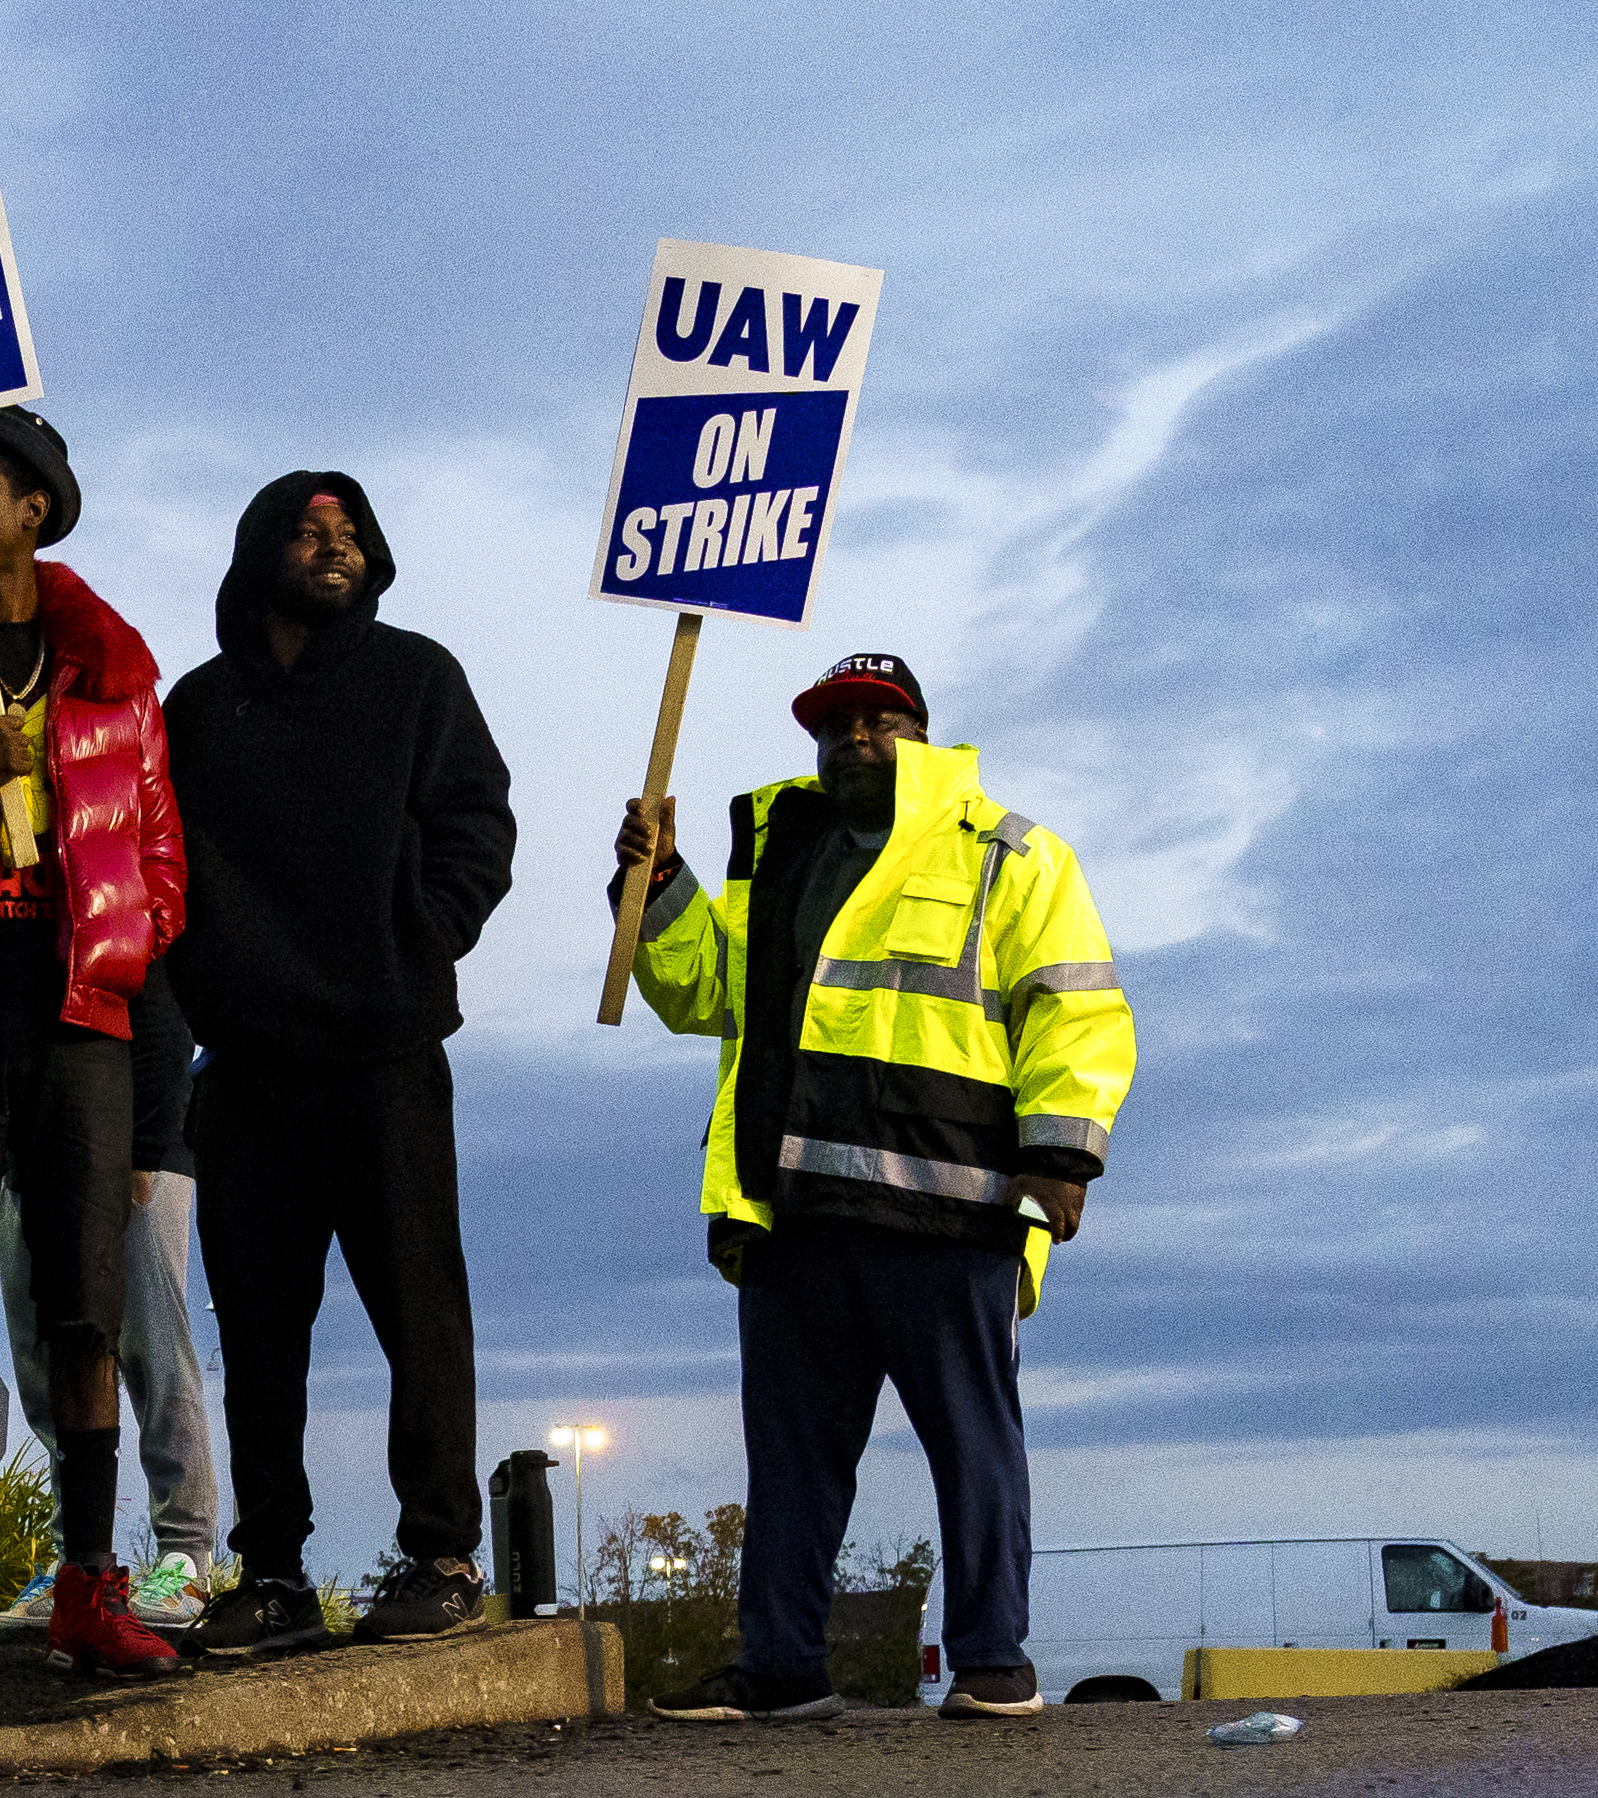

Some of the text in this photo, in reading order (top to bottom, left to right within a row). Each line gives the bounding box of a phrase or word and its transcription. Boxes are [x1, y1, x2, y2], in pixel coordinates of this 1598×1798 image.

[655, 276, 860, 382] UAW
[692, 408, 777, 488] ON
[615, 486, 819, 581] STRIKE
